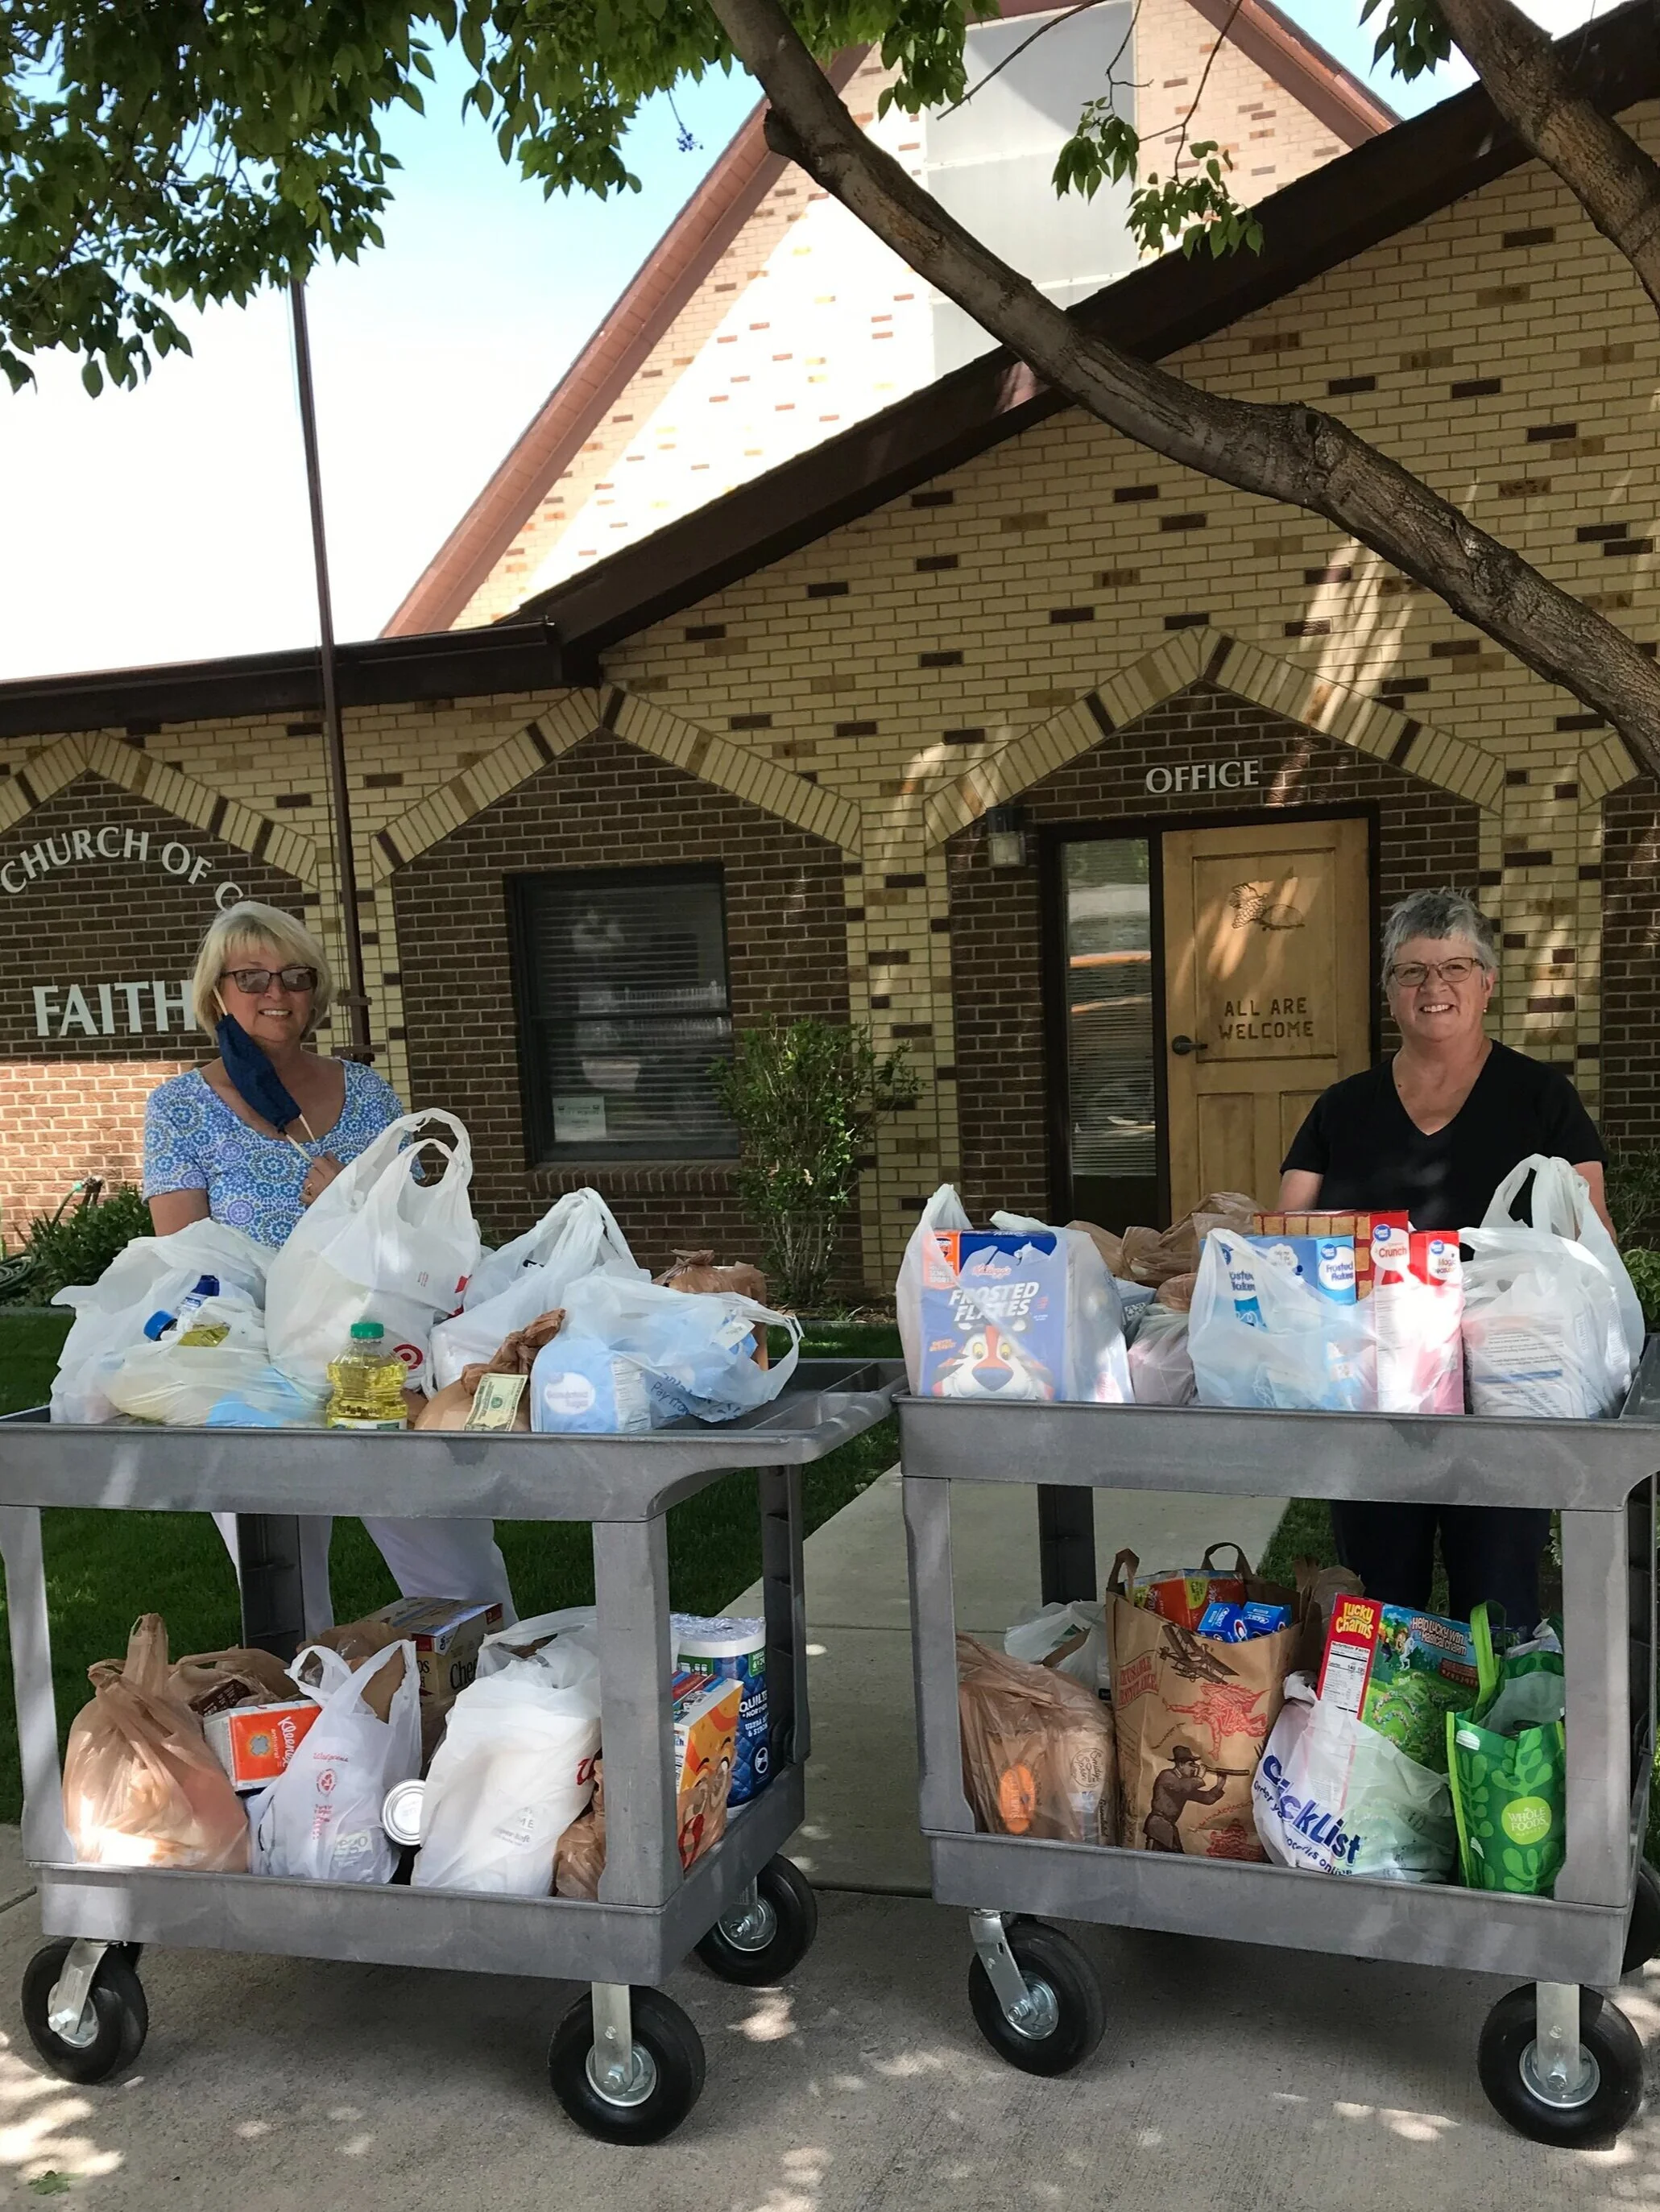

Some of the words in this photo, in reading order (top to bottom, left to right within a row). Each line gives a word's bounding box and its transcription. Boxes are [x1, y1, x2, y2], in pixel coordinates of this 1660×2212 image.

[1145, 760, 1259, 794] OFFICE
[1, 826, 149, 895] CHURCH
[162, 841, 213, 885] OF
[31, 979, 197, 1036] FAITH
[1224, 1000, 1260, 1017] ALL
[1270, 998, 1307, 1015] ARE
[1219, 1020, 1314, 1040] WELCOME
[1378, 1247, 1407, 1258] Crunch
[1326, 1262, 1353, 1273] Frosted
[949, 1282, 1040, 1305] FROSTED
[651, 1382, 669, 1402] Pay
[1343, 1602, 1375, 1625] Lucky
[1335, 1616, 1374, 1639] Charms
[1412, 1617, 1429, 1631] Help
[277, 1715, 297, 1768] Kleenex
[1507, 1806, 1546, 1822] WHOLE
[1511, 1817, 1547, 1832] FOODS
